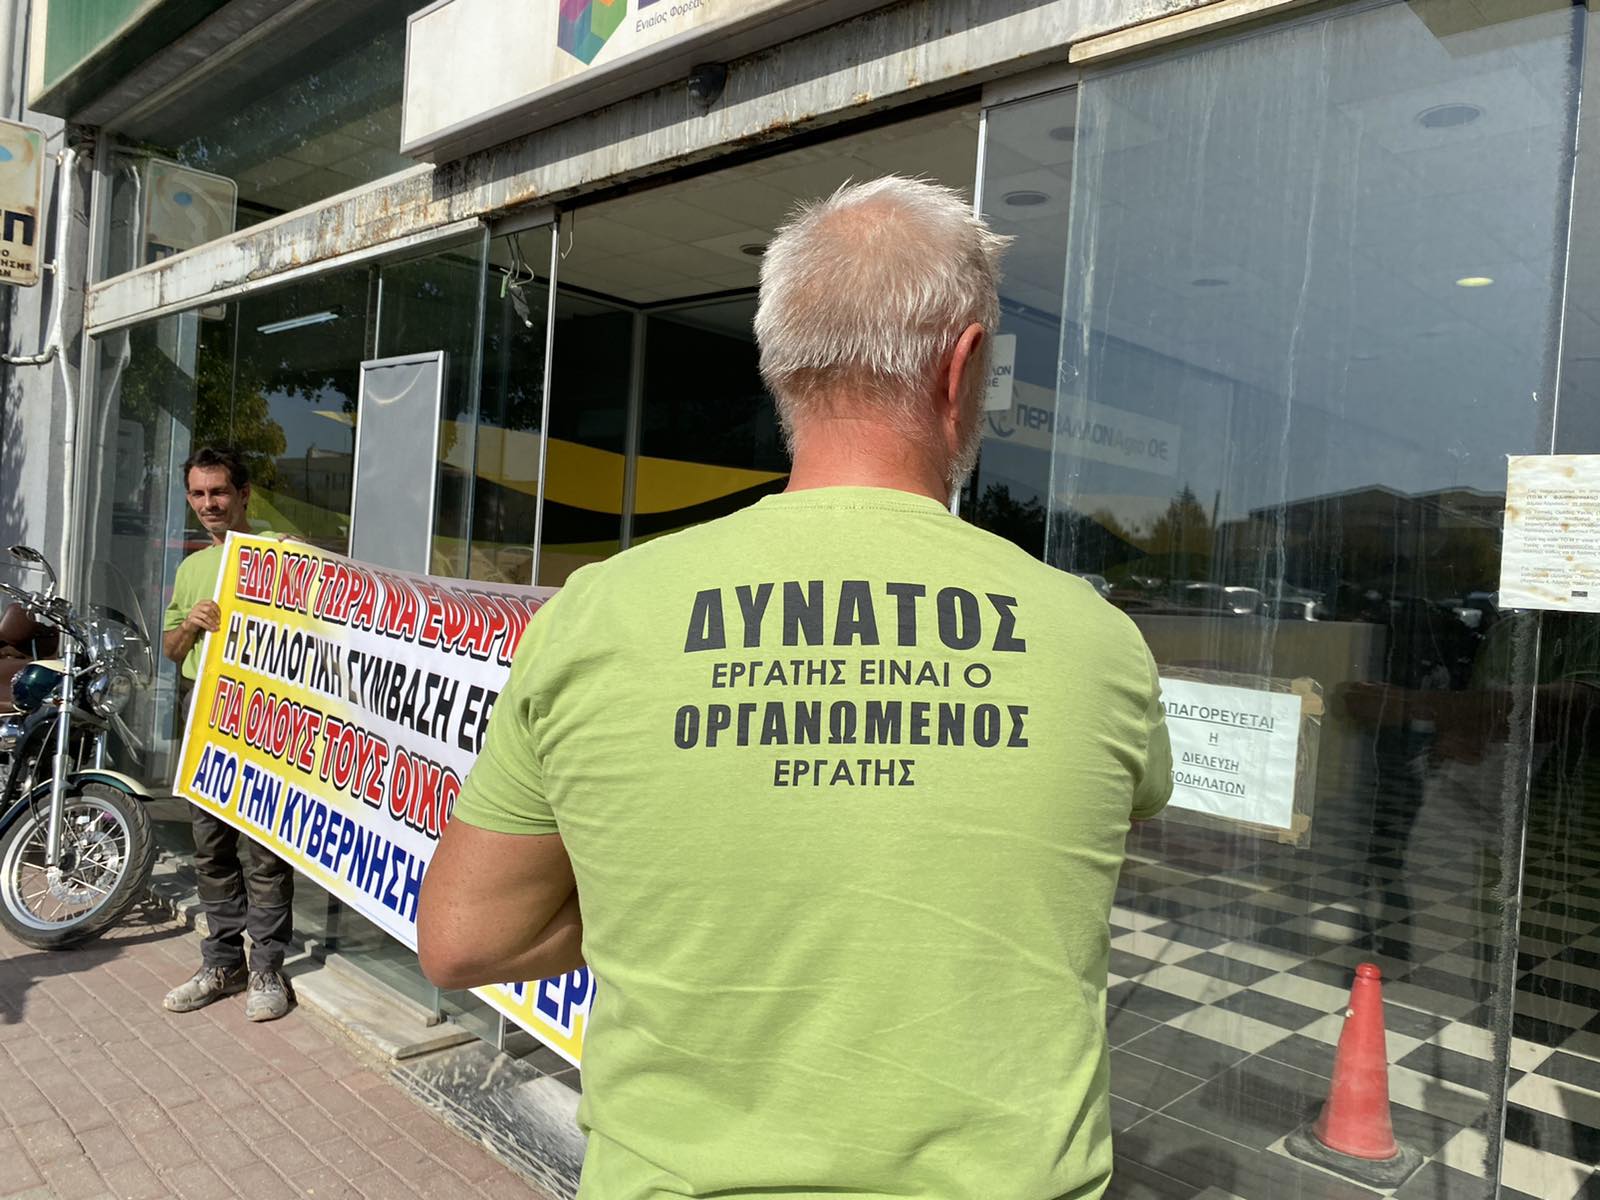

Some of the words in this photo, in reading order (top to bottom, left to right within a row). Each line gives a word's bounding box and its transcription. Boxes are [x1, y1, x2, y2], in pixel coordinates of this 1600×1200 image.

[236, 546, 279, 605] ΕΔΩ
[276, 552, 318, 614] ΚΑΙ
[313, 559, 379, 631] ΤΩΡΑ
[374, 571, 420, 644] ΝΑ
[684, 580, 1027, 653] ΔΥΝΑΤΟΣ
[224, 613, 241, 662] Η
[241, 619, 342, 697] ΣΥΛΛΟΓΙΚΗ
[348, 649, 460, 743] ΣΥΜΒΑΣΗ
[712, 660, 847, 688] ΕΡΓΑΤΗΣ
[860, 659, 950, 687] ΕΙΝΑΙ
[964, 663, 991, 688] Ο
[209, 674, 245, 738] ΓΙΑ
[245, 688, 323, 772] ΟΛΟΥΣ
[319, 713, 389, 809] ΤΟΥΣ
[674, 700, 1029, 749] ΟΡΓΑΝΩΜΕΝΟΣ
[1209, 732, 1219, 744] Η
[773, 759, 915, 786] ΕΡΓΑΤΗΣ
[1182, 752, 1240, 772] ΔΙΕΛΕΥΣΗ
[192, 745, 237, 803] ΑΠΟ
[238, 764, 282, 830] ΤΗΝ
[279, 787, 425, 923] ΚΥΒΕΡΝΗΣΗ
[537, 965, 597, 1029] ΕΡ
